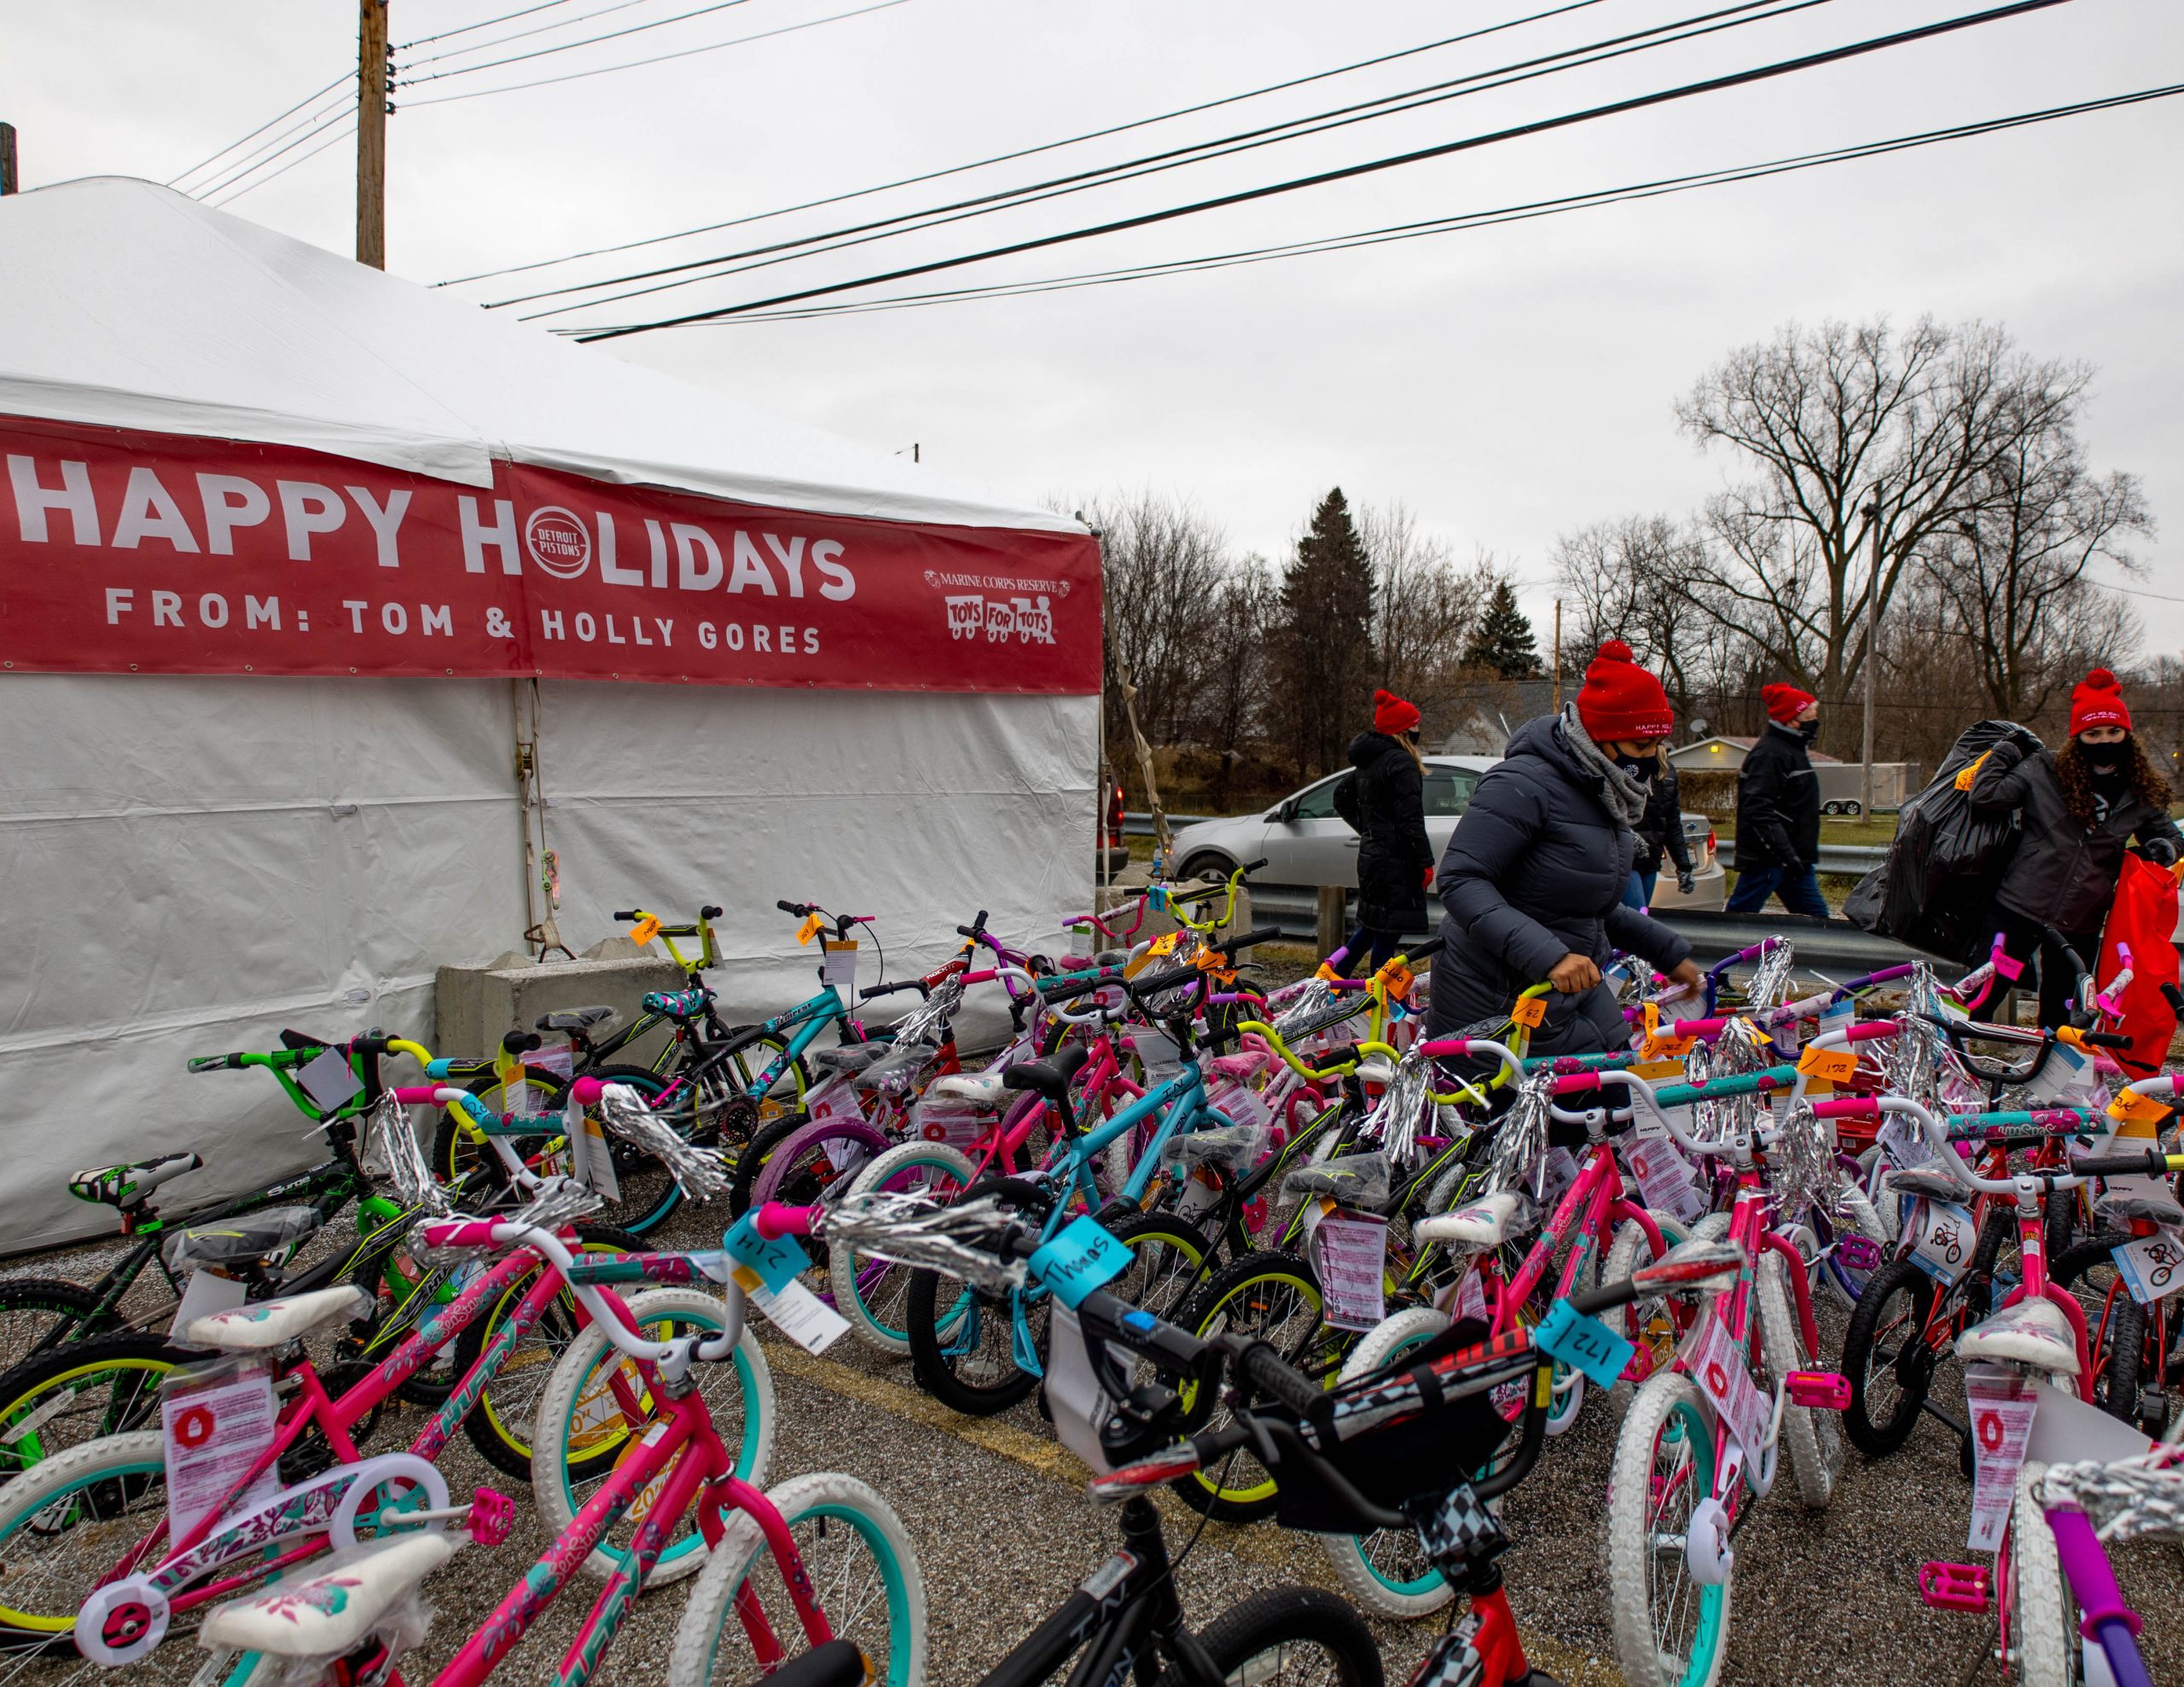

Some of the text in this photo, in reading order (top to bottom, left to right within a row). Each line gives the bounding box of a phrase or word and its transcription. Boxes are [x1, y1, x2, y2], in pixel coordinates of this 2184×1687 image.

[6, 454, 413, 568] HAPPY
[537, 529, 578, 544] DETROIT
[539, 541, 580, 557] PISTONS
[939, 573, 1057, 593] MARINE CORPS RESERVE
[105, 588, 821, 655] FROM: TOM & HOLLY GORES
[949, 600, 982, 624] TOYS
[988, 606, 1012, 629] FOR
[1019, 612, 1048, 633] TOTS
[775, 1003, 812, 1026] TEMPEST
[266, 1175, 311, 1197] Surge
[435, 1292, 489, 1338] SeaStar
[439, 1319, 517, 1439] HUFFY
[548, 1522, 607, 1586] SeaStar
